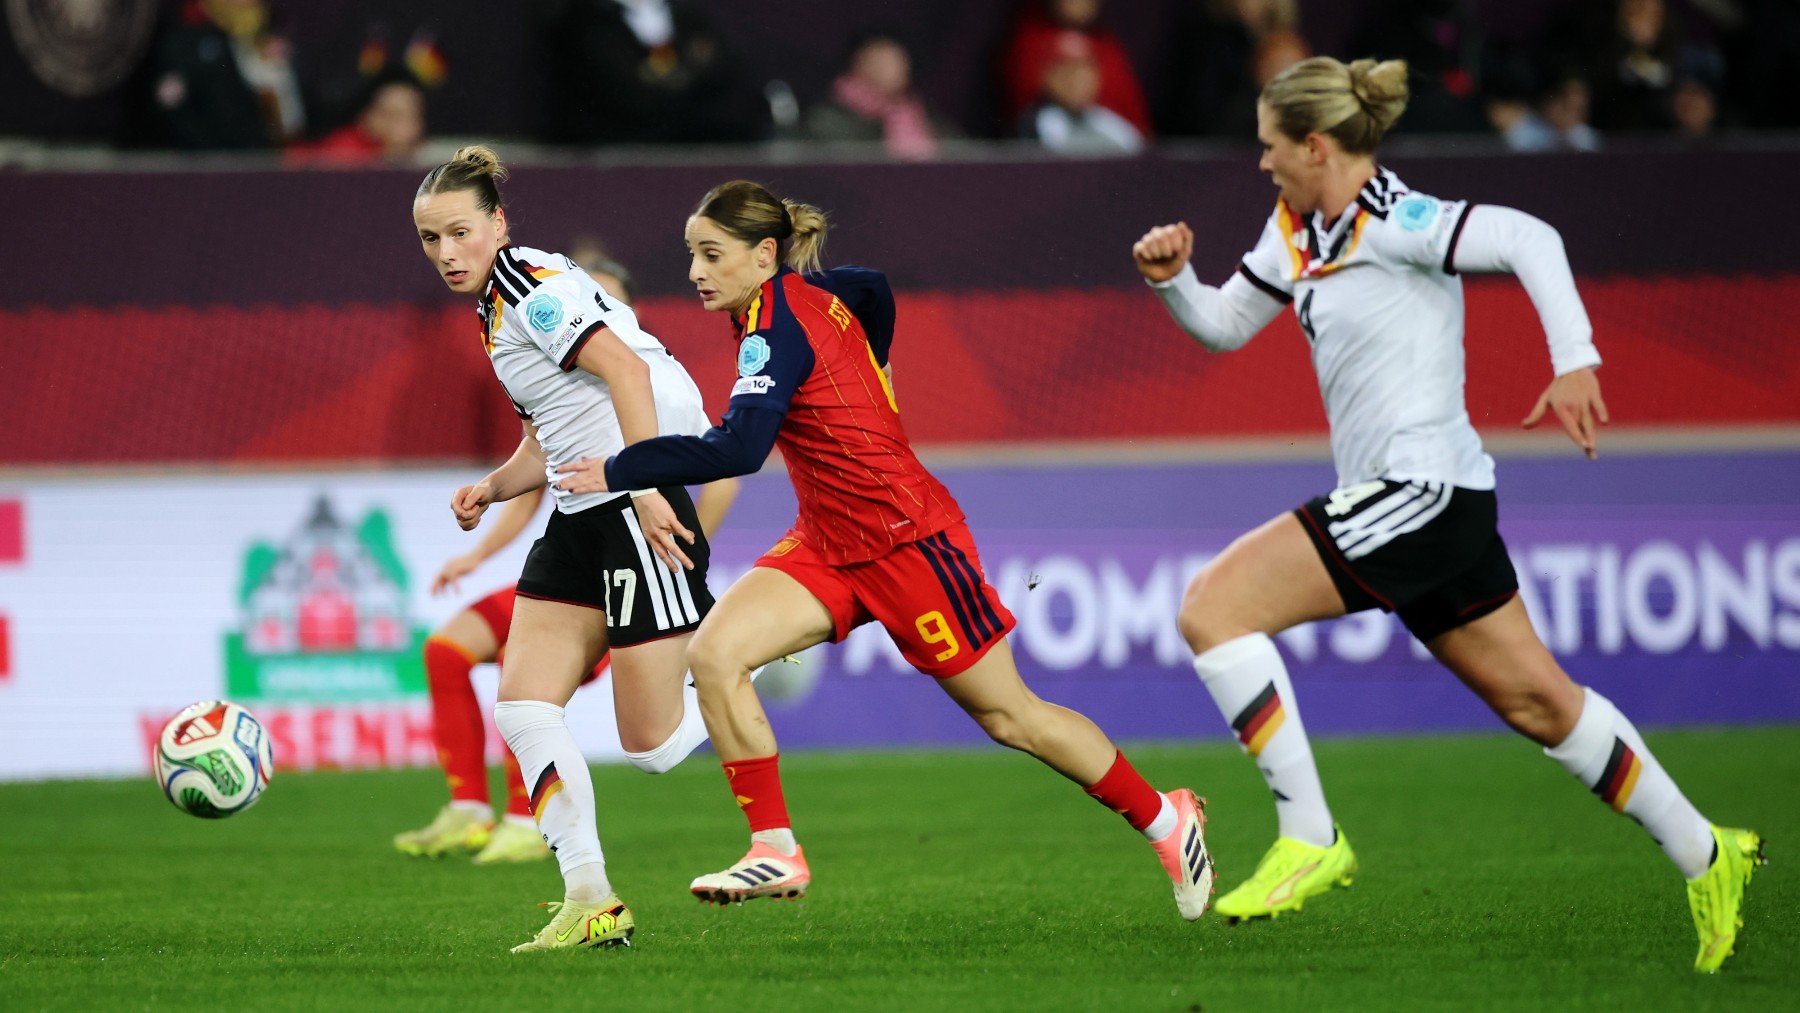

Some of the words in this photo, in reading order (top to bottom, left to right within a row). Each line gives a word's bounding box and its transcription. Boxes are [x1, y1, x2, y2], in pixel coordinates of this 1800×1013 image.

[1324, 479, 1387, 517] 4
[603, 568, 637, 627] 17
[1409, 538, 1800, 660] TIONS
[915, 610, 959, 662] 9
